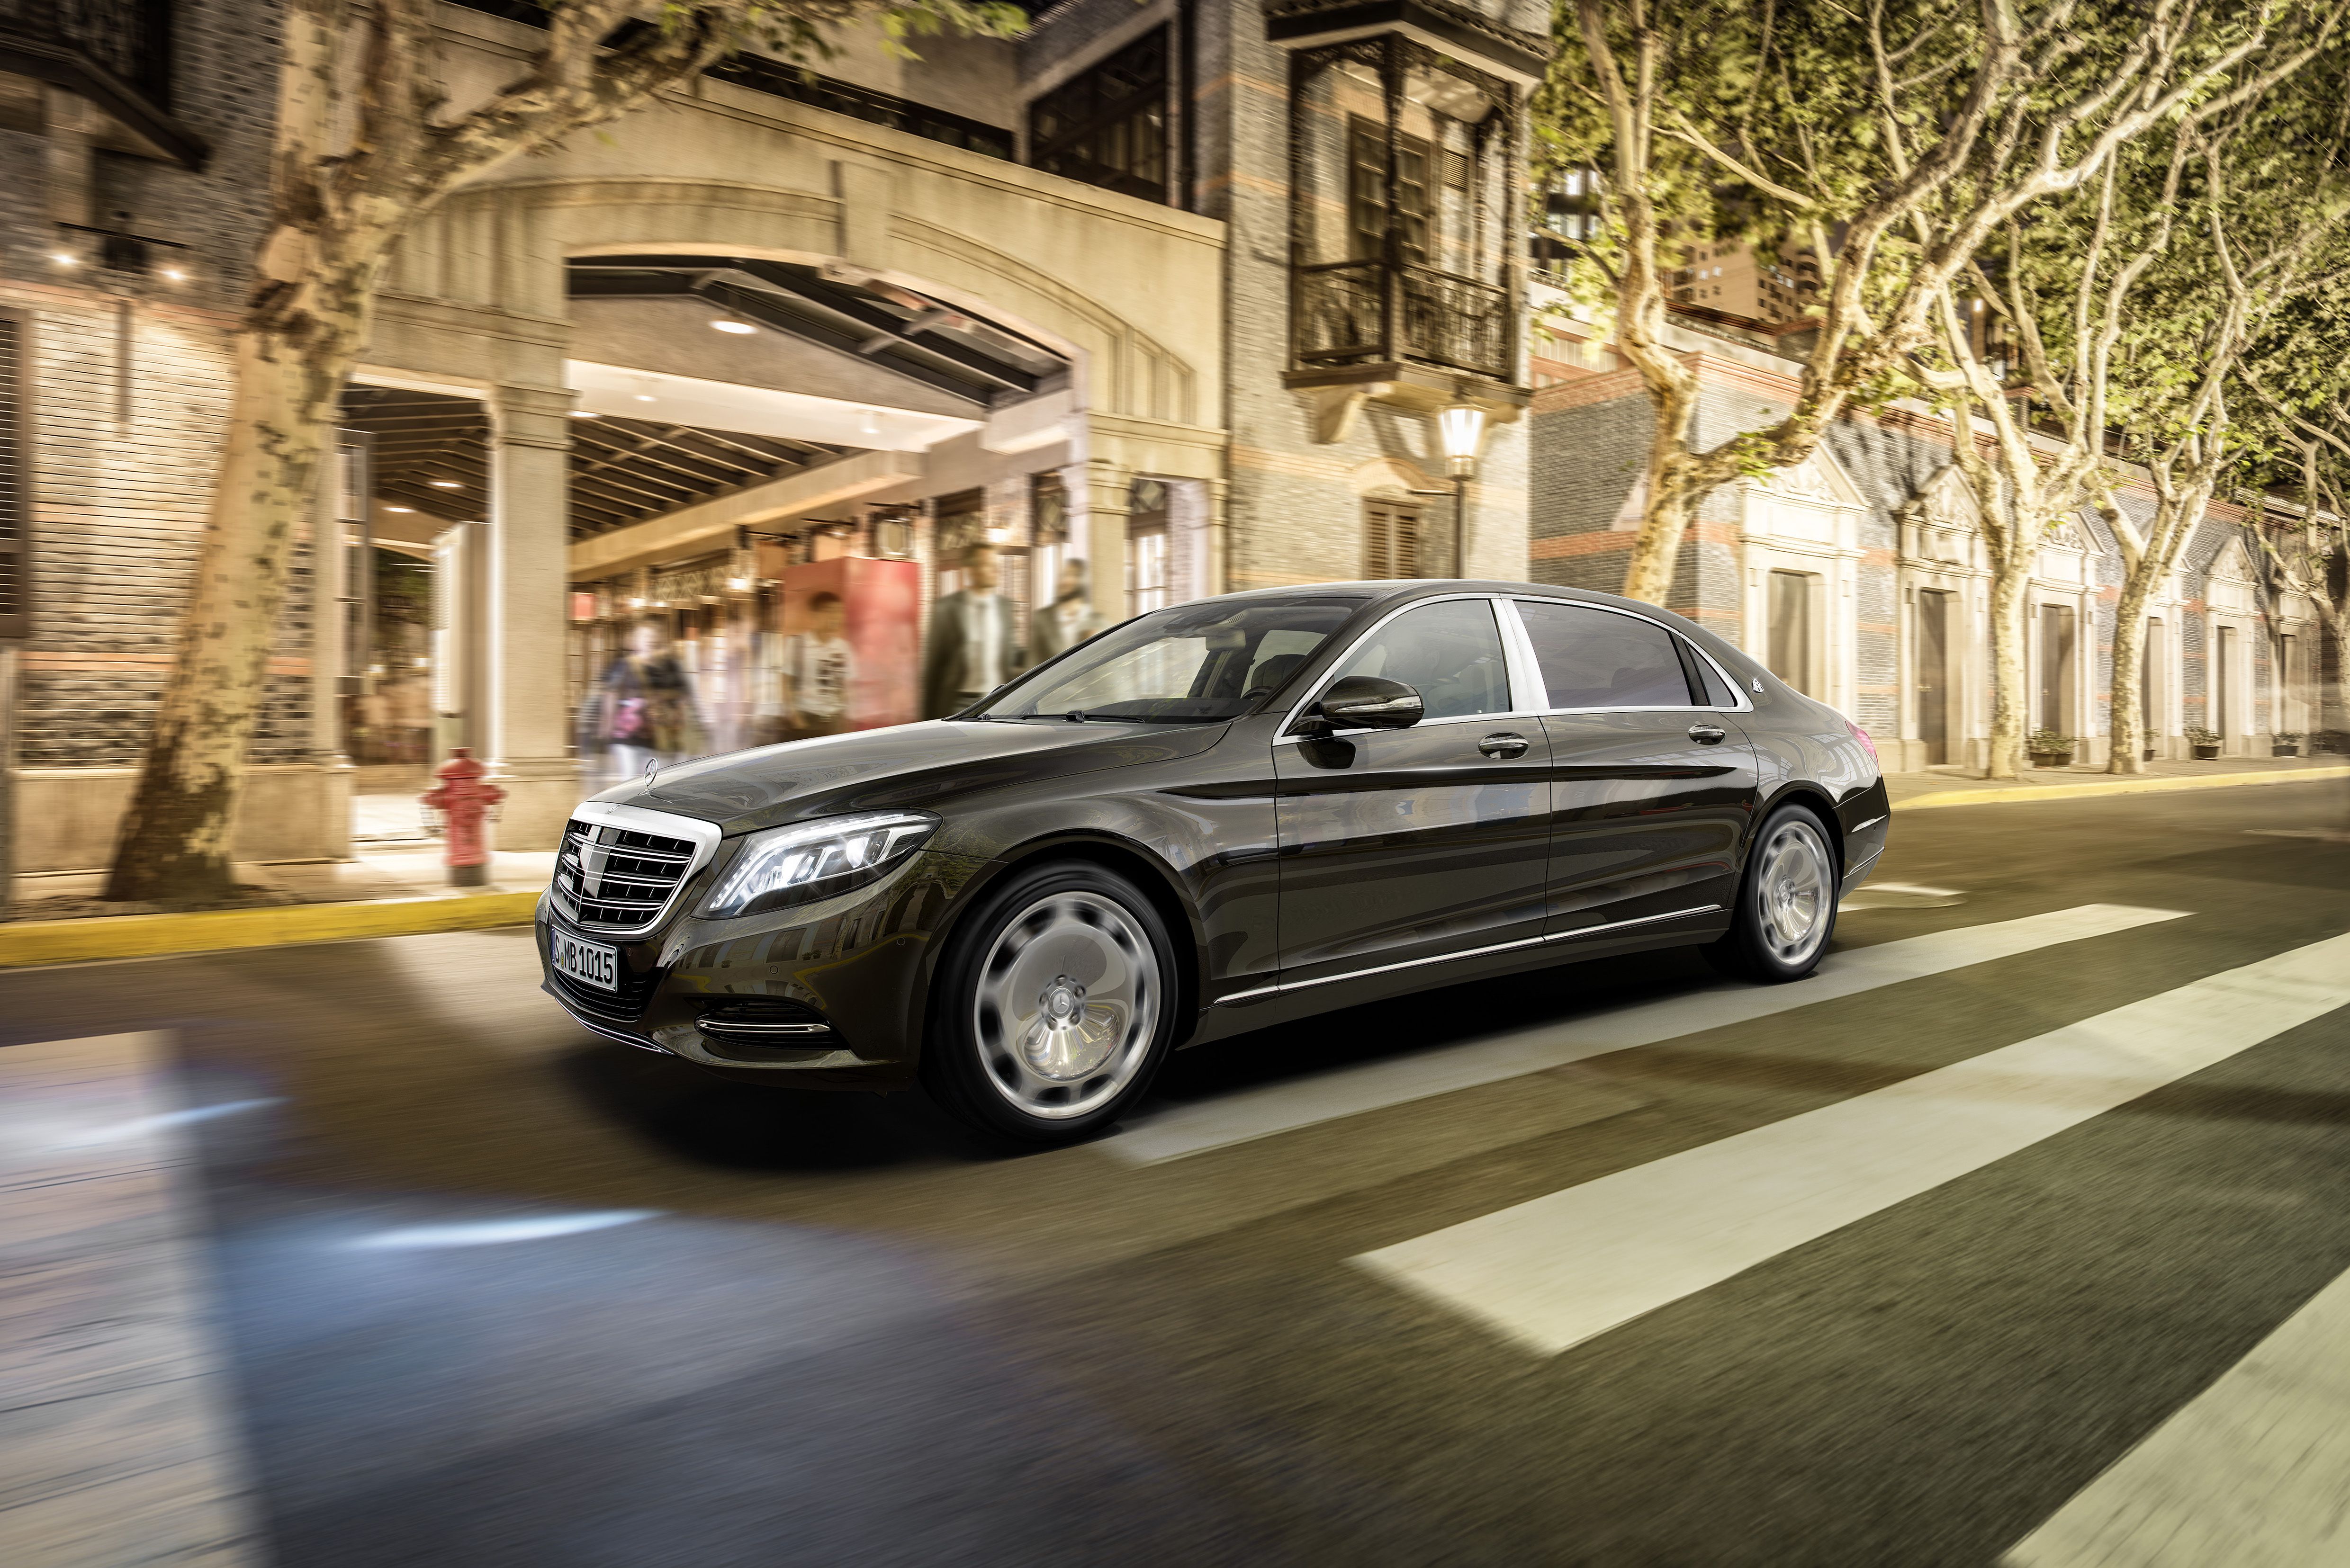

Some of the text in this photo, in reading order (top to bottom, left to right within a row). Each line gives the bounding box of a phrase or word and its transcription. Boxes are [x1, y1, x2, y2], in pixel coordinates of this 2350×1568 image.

[555, 934, 613, 984] S MB 1015
